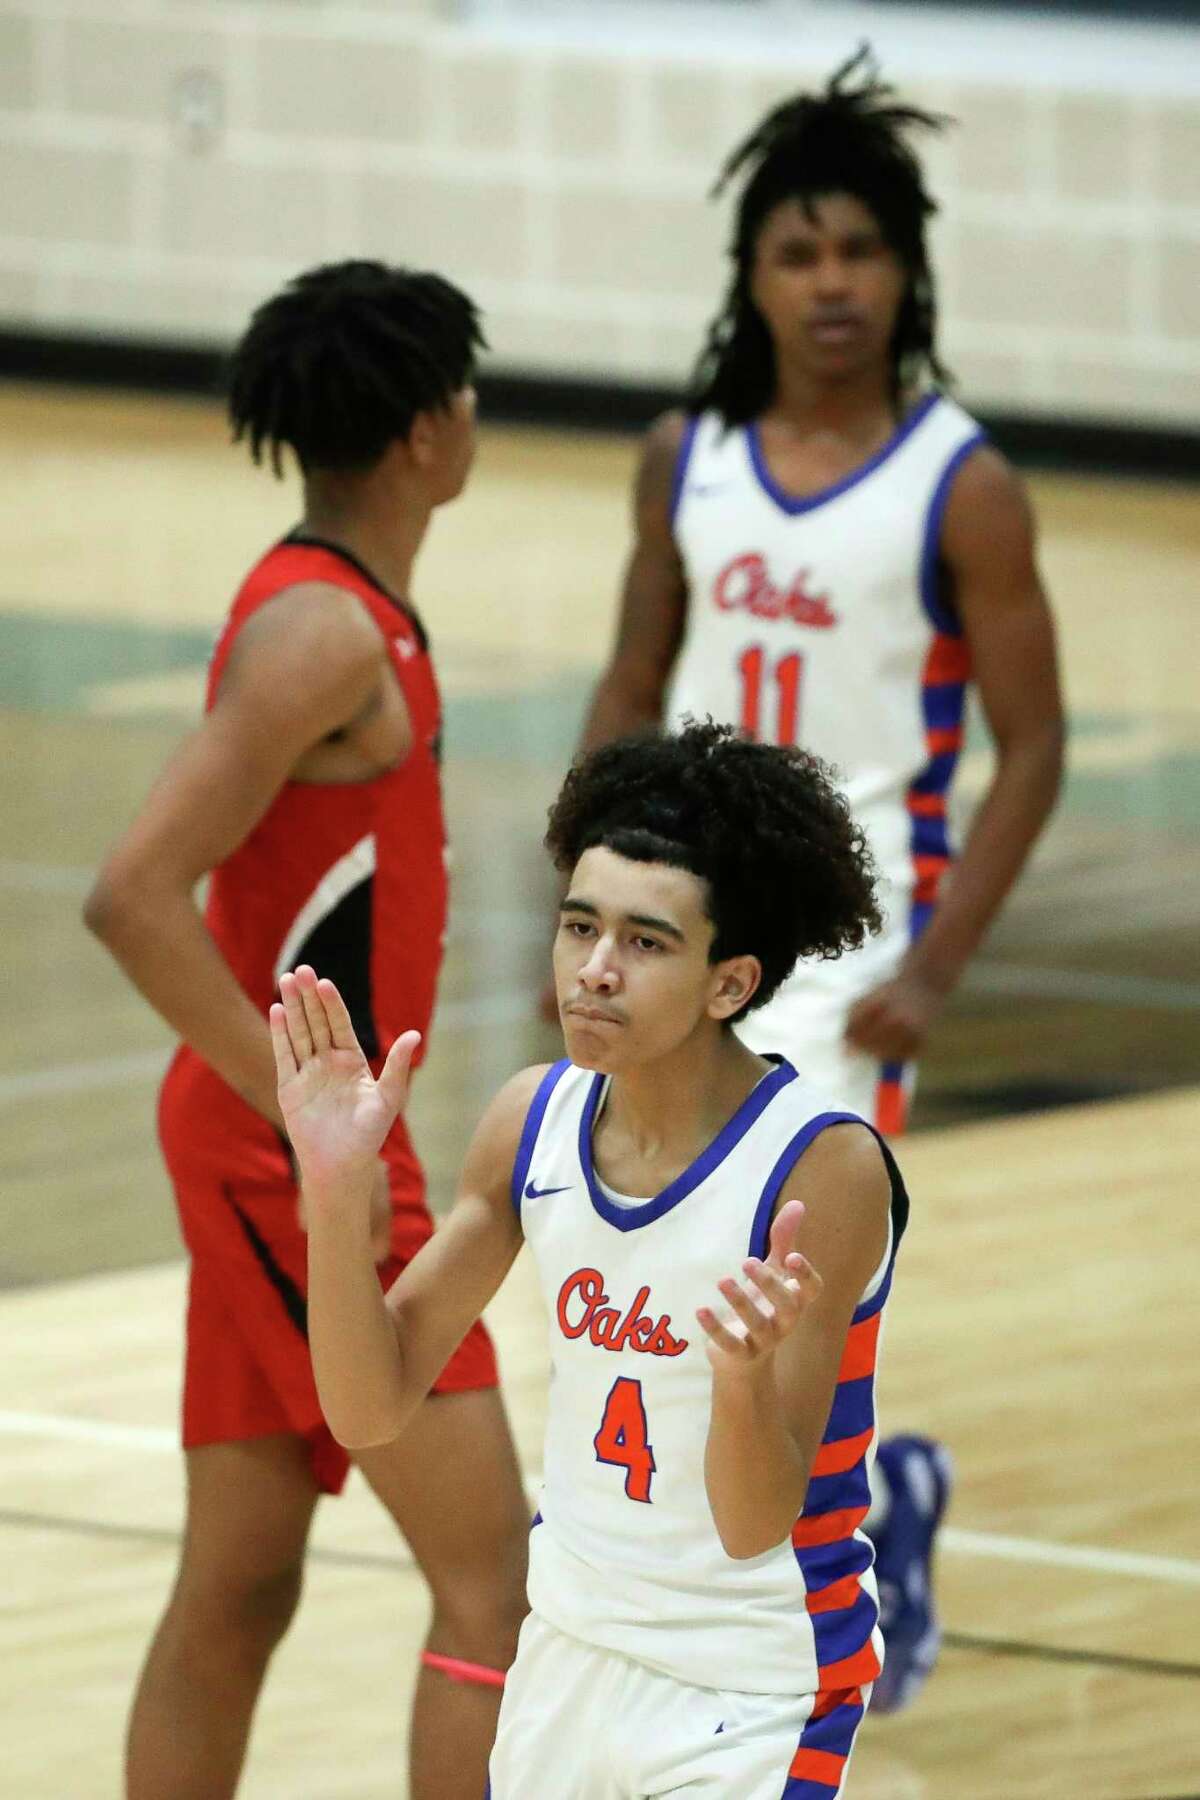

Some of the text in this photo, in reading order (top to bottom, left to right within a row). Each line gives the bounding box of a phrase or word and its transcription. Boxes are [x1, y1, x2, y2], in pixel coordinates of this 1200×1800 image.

[712, 552, 838, 629] Oaks
[738, 646, 802, 749] 11
[557, 1267, 688, 1356] Oaks
[593, 1376, 656, 1504] 4
